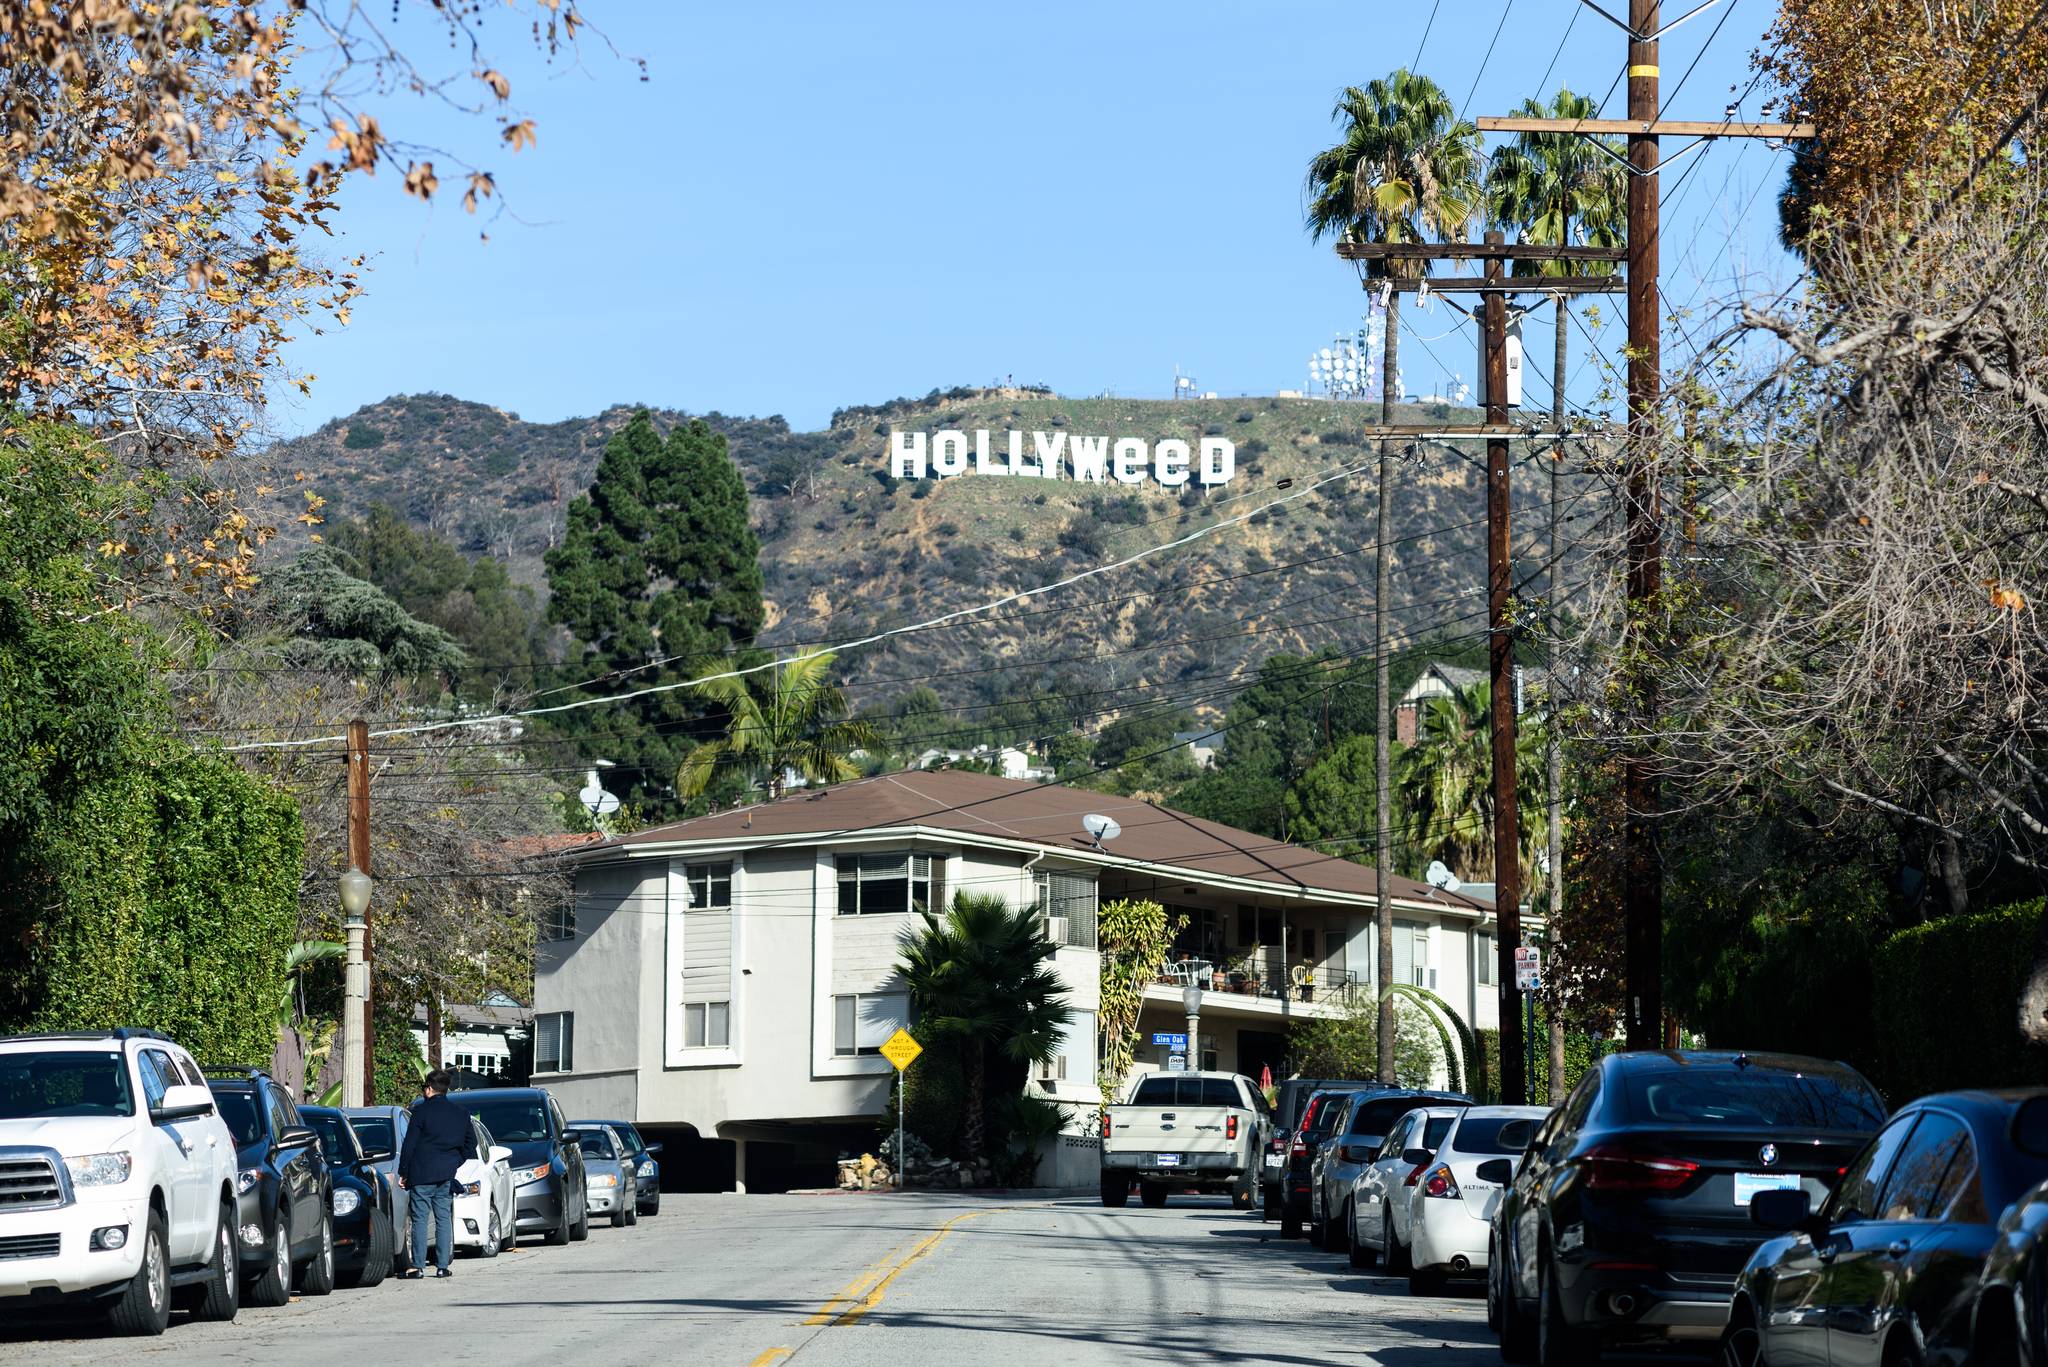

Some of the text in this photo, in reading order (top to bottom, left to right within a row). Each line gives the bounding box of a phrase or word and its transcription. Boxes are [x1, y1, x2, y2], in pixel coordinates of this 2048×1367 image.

[1516, 950, 1526, 960] NO
[1156, 1035, 1184, 1043] Glen Oak
